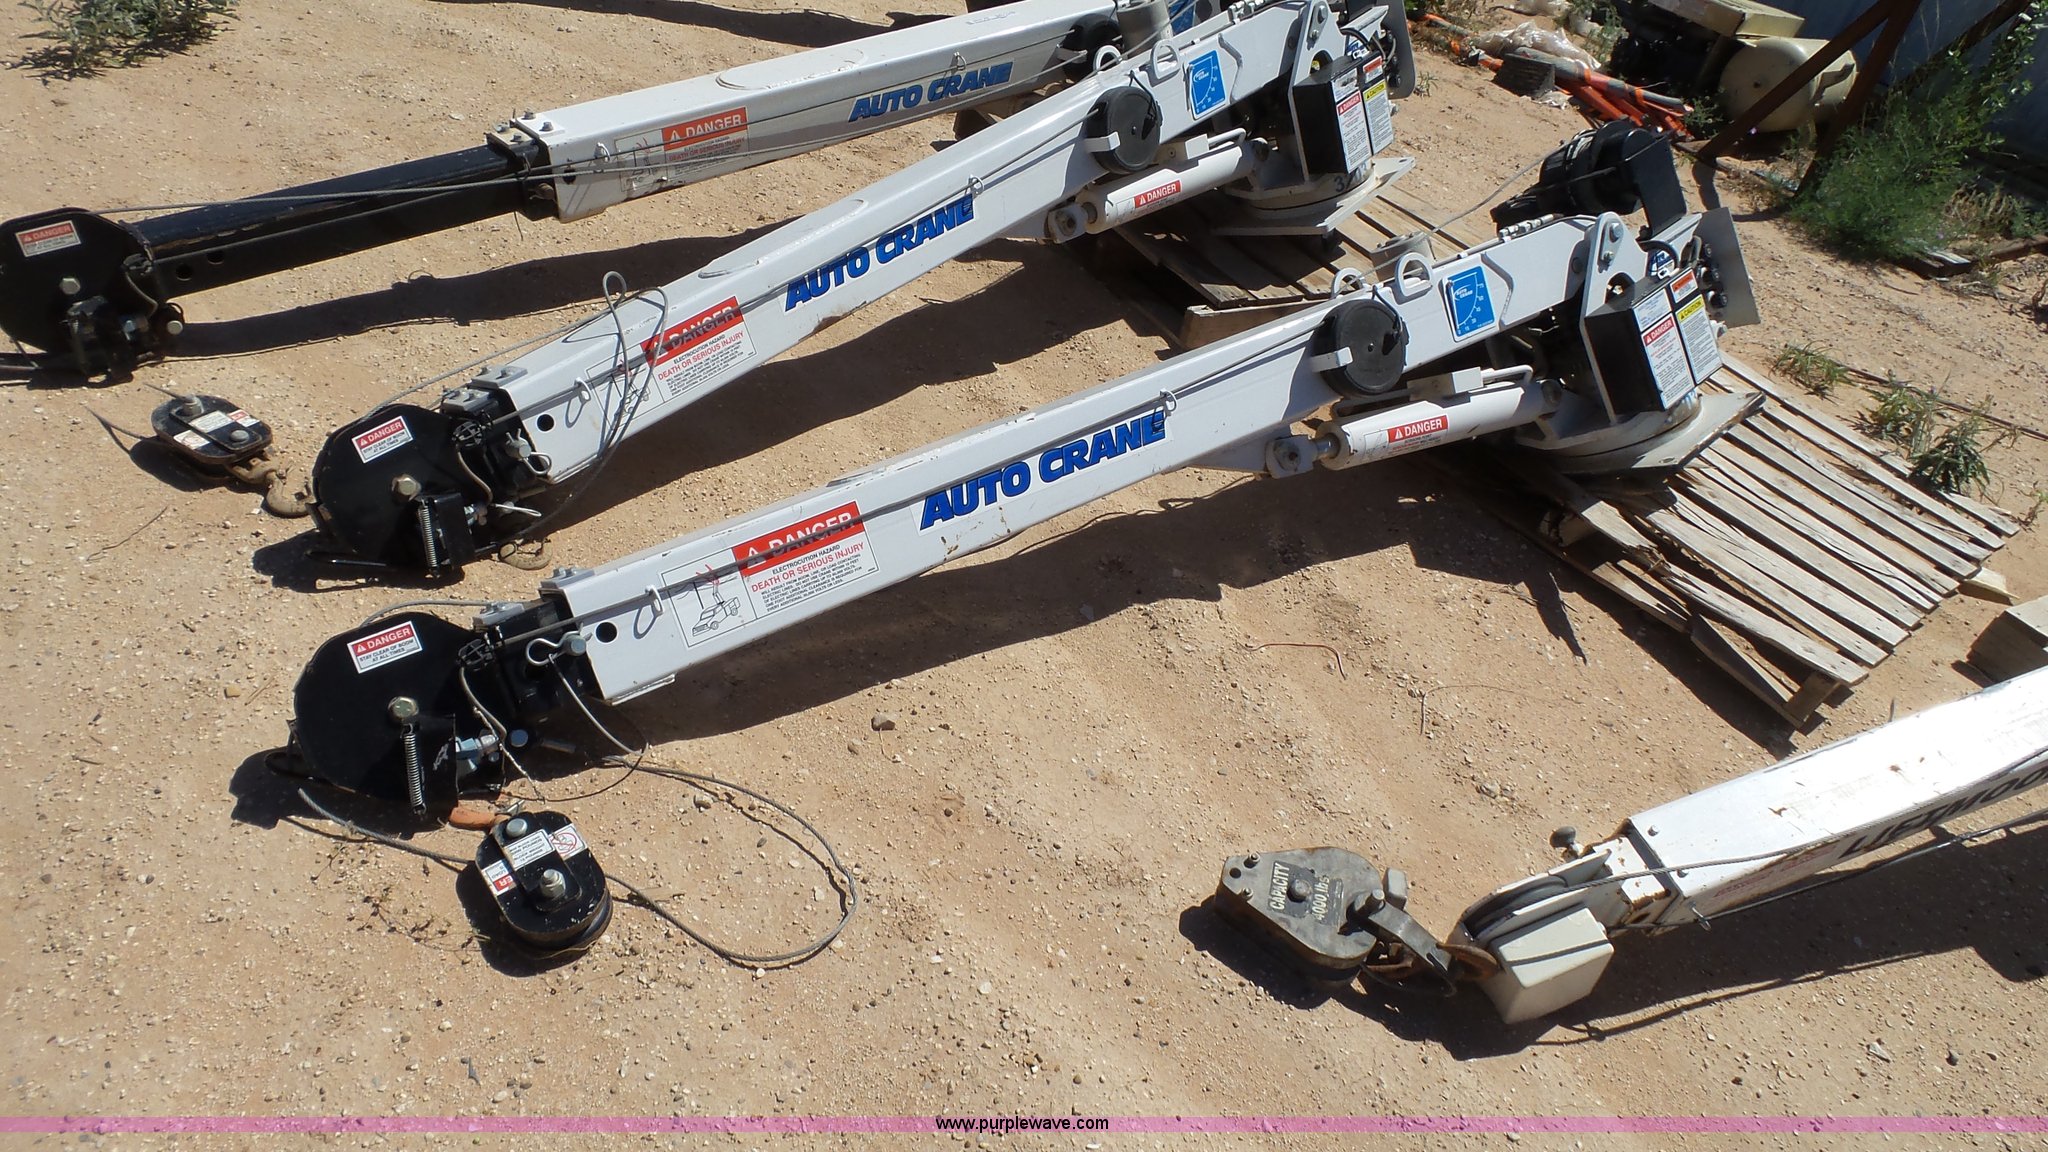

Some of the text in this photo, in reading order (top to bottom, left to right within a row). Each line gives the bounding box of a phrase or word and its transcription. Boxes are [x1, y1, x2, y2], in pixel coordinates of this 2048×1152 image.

[848, 61, 1014, 122] AUTO CRANE
[685, 114, 742, 137] DANGER
[1146, 184, 1177, 202] DANGER
[32, 225, 71, 239] DANGER
[785, 194, 975, 312] AUTO CRANE
[667, 305, 736, 349] DANGER
[1650, 321, 1673, 340] DANGER
[657, 331, 744, 380] DEATH OR SERIOUS INJURY
[367, 421, 402, 442] DANGER
[1403, 418, 1442, 436] DANGER
[920, 409, 1166, 531] AUTO CRANE
[768, 510, 855, 557] DANGER
[750, 542, 865, 592] DEATH OR SERIOUS INJURY
[771, 544, 840, 575] ELECTROCUTION HAZARD
[366, 627, 410, 649] DANGER
[373, 647, 389, 656] CLEAR
[1269, 862, 1290, 910] CAPACITY
[1311, 894, 1328, 921] 4000
